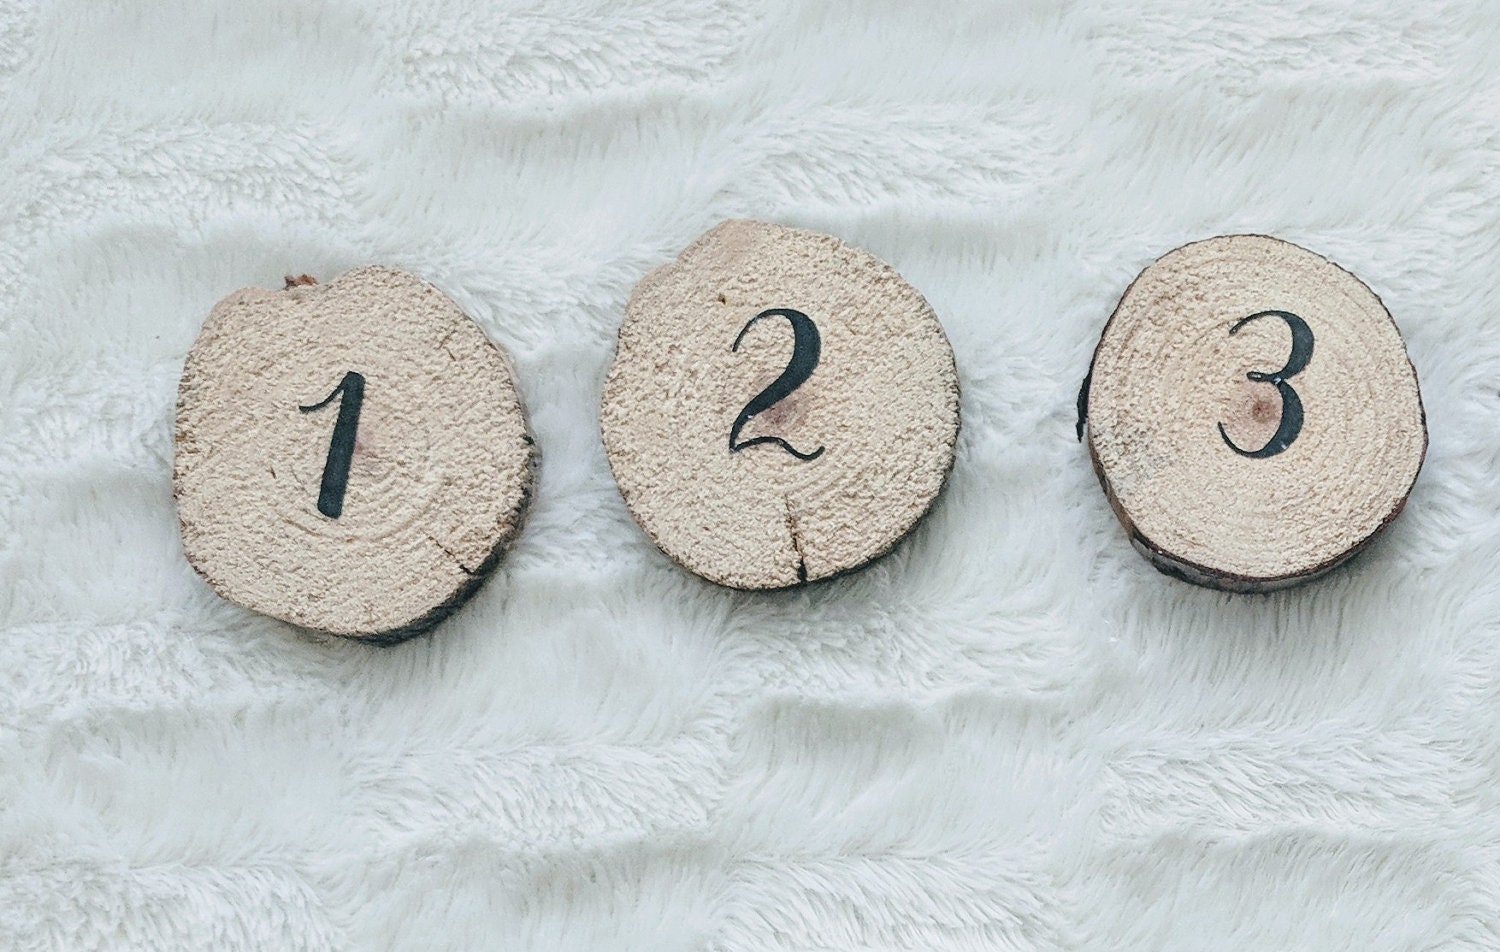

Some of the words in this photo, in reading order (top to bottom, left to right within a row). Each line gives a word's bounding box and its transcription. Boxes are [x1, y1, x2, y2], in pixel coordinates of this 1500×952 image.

[298, 370, 367, 520] 1
[728, 308, 826, 462] 2
[1217, 309, 1315, 459] 3
